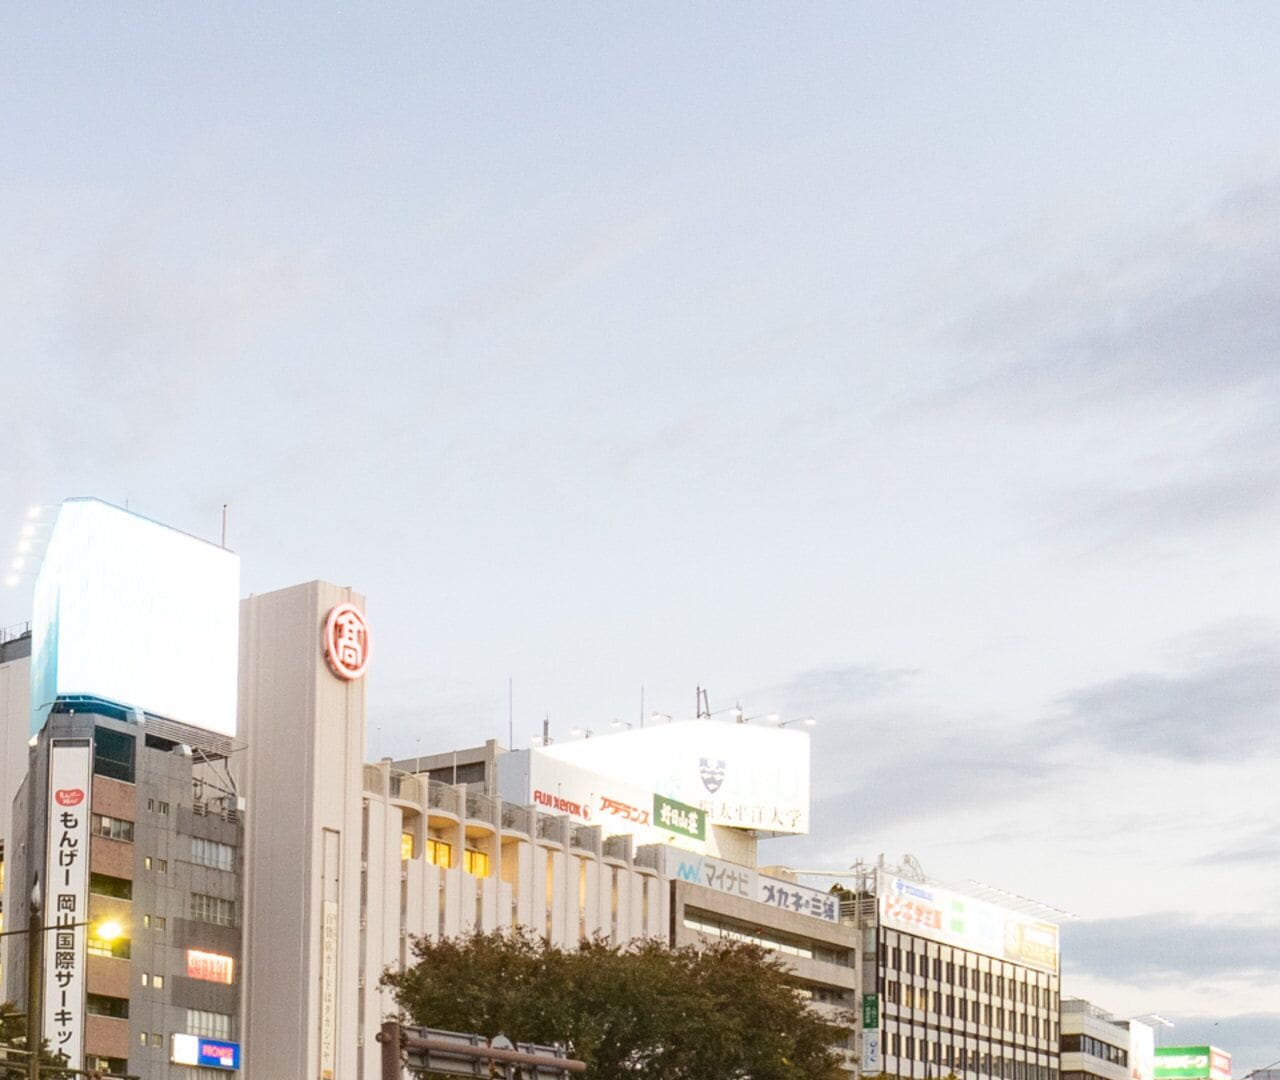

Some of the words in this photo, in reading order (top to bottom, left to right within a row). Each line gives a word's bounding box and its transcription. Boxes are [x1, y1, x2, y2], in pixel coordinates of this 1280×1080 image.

[533, 789, 552, 807] FUJI
[599, 795, 650, 827] アデランス
[59, 811, 78, 886] もんげー
[704, 862, 750, 897] マイナビ
[54, 893, 76, 1062] 岡山国際サーキット
